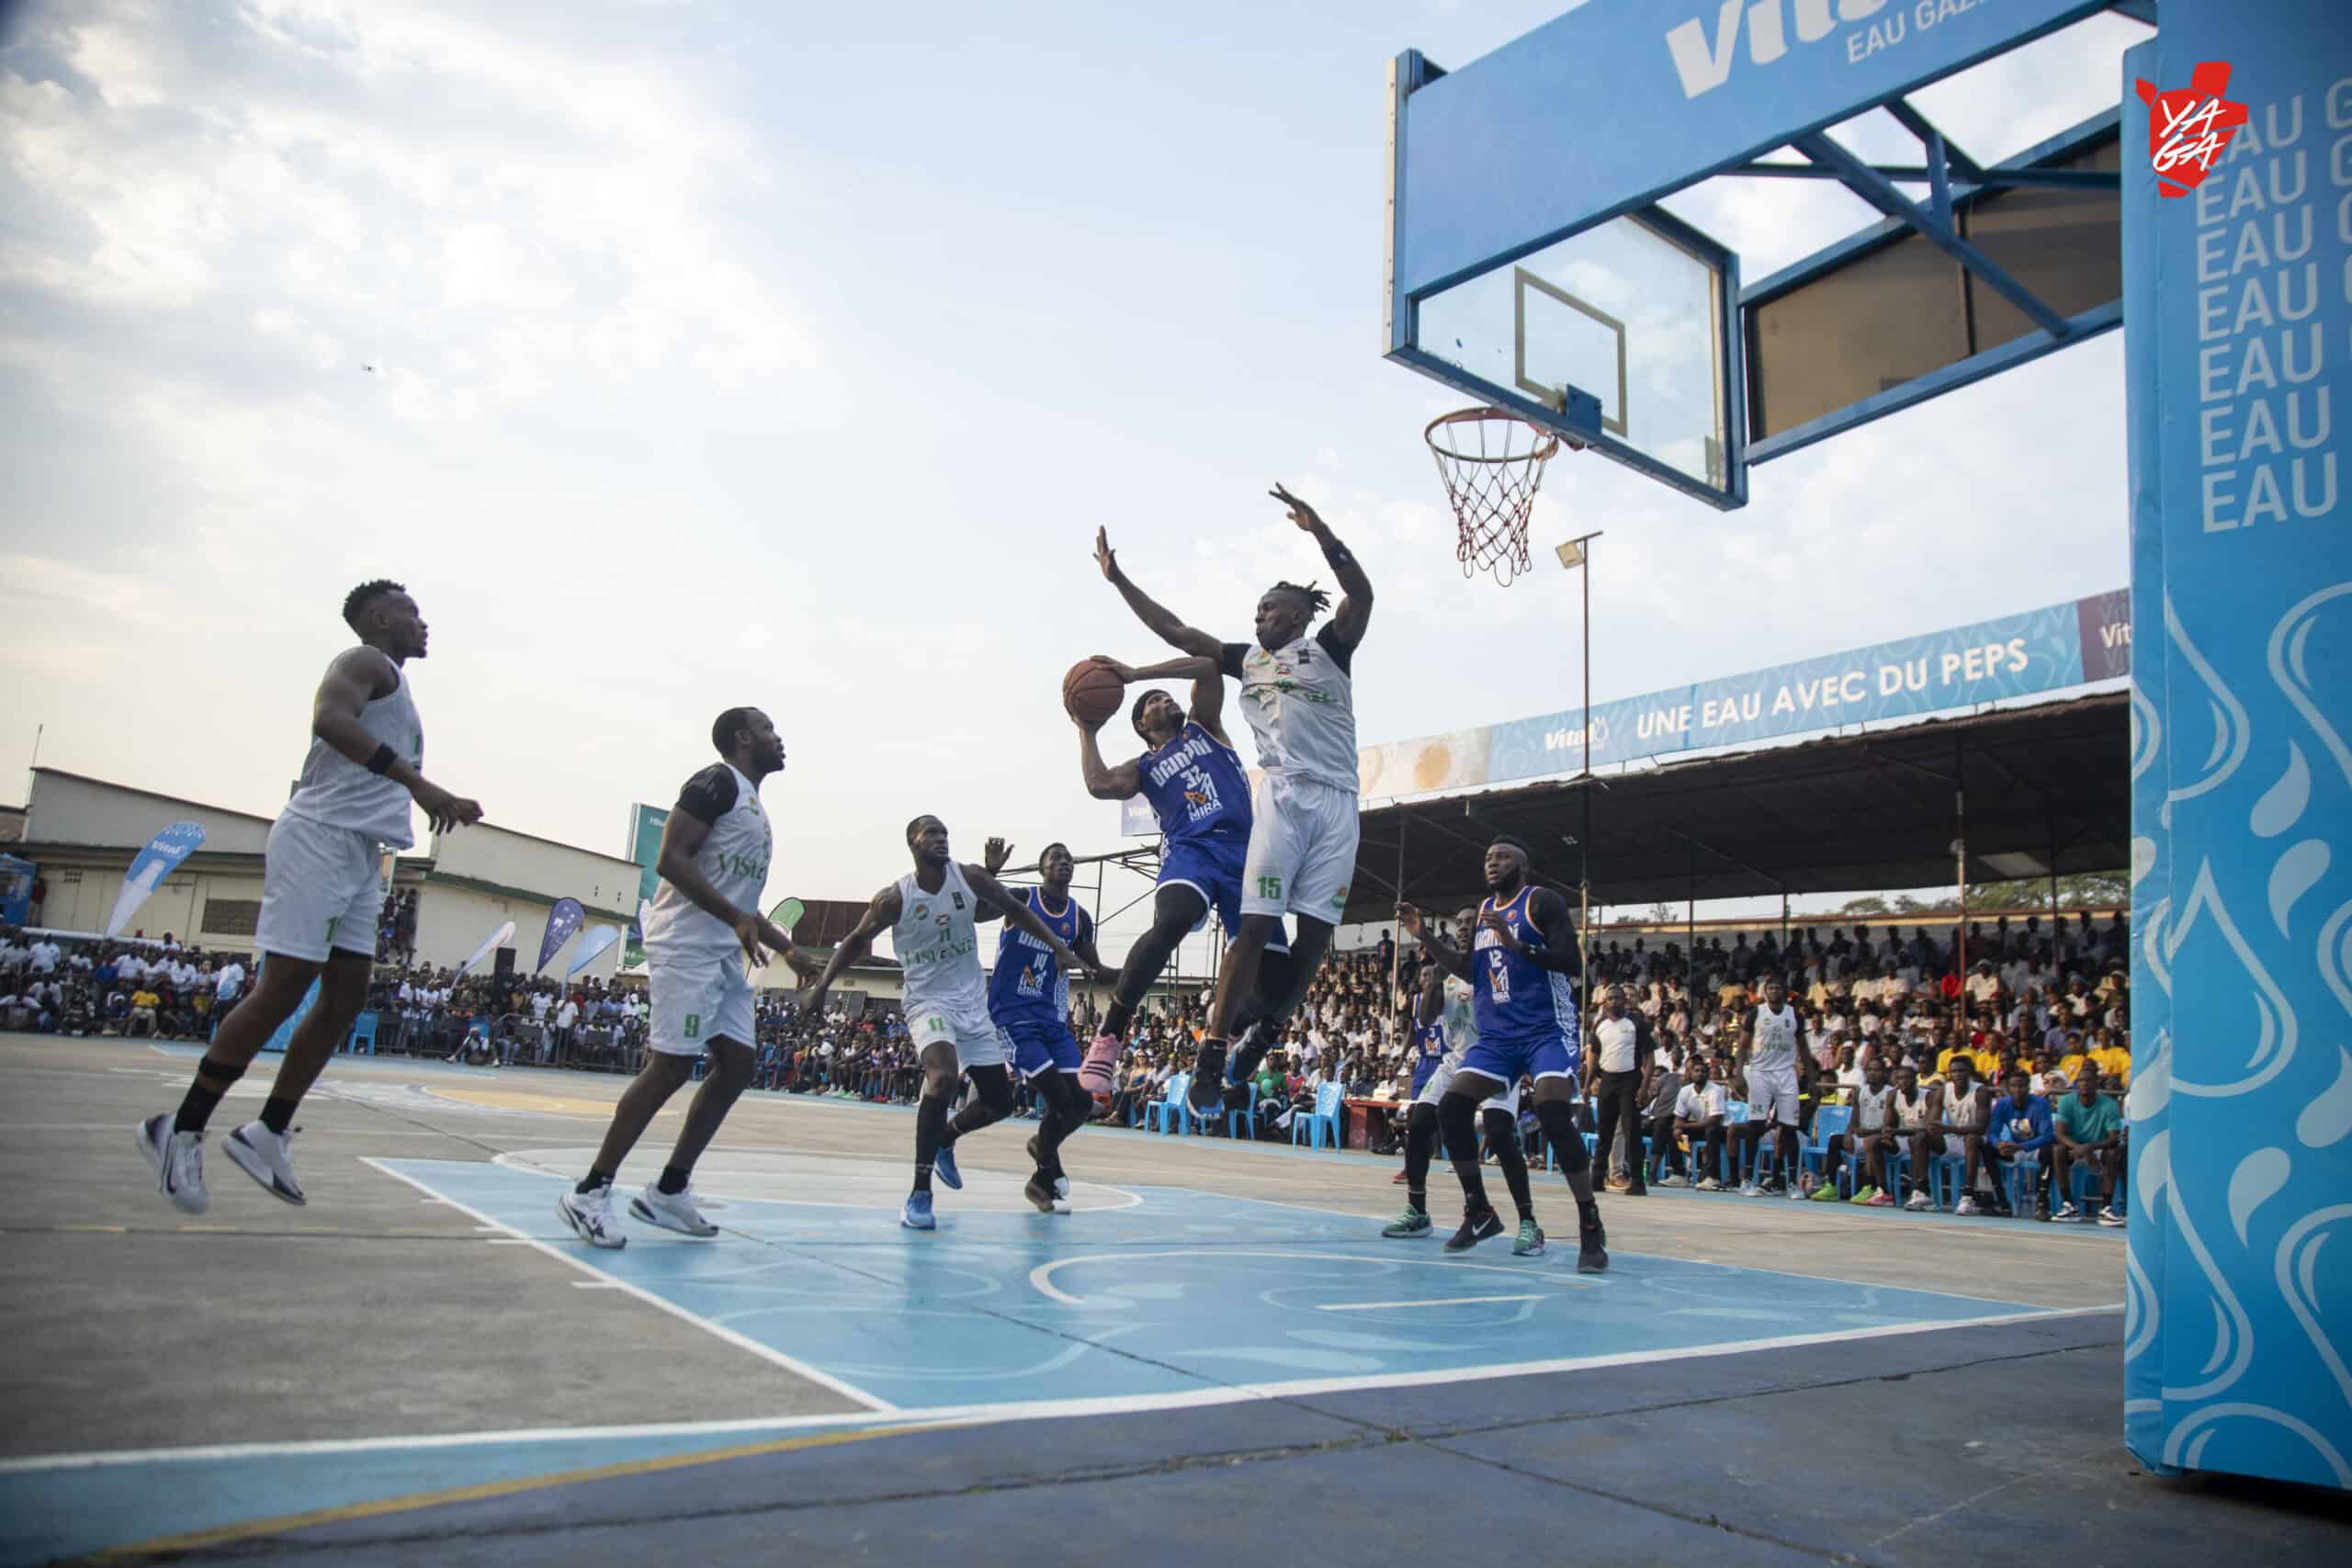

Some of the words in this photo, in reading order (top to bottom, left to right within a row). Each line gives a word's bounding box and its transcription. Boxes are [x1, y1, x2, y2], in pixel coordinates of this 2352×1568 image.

[1847, 12, 1906, 64] EAU
[2197, 149, 2307, 227] EAU
[2197, 204, 2313, 284] EAU
[2199, 262, 2319, 342] EAU
[2199, 321, 2324, 402] EAU
[2200, 385, 2331, 467] EAU
[2202, 451, 2337, 533] EAU
[1636, 705, 1693, 739] UNE
[1702, 692, 1762, 728] EAU
[1771, 671, 1867, 716] AVEC
[1879, 659, 1928, 696] DU
[1940, 637, 2029, 686] PEPS
[1257, 875, 1282, 900] 15
[1488, 949, 1503, 968] 12
[684, 1013, 699, 1039] 9
[927, 1017, 944, 1032] 11
